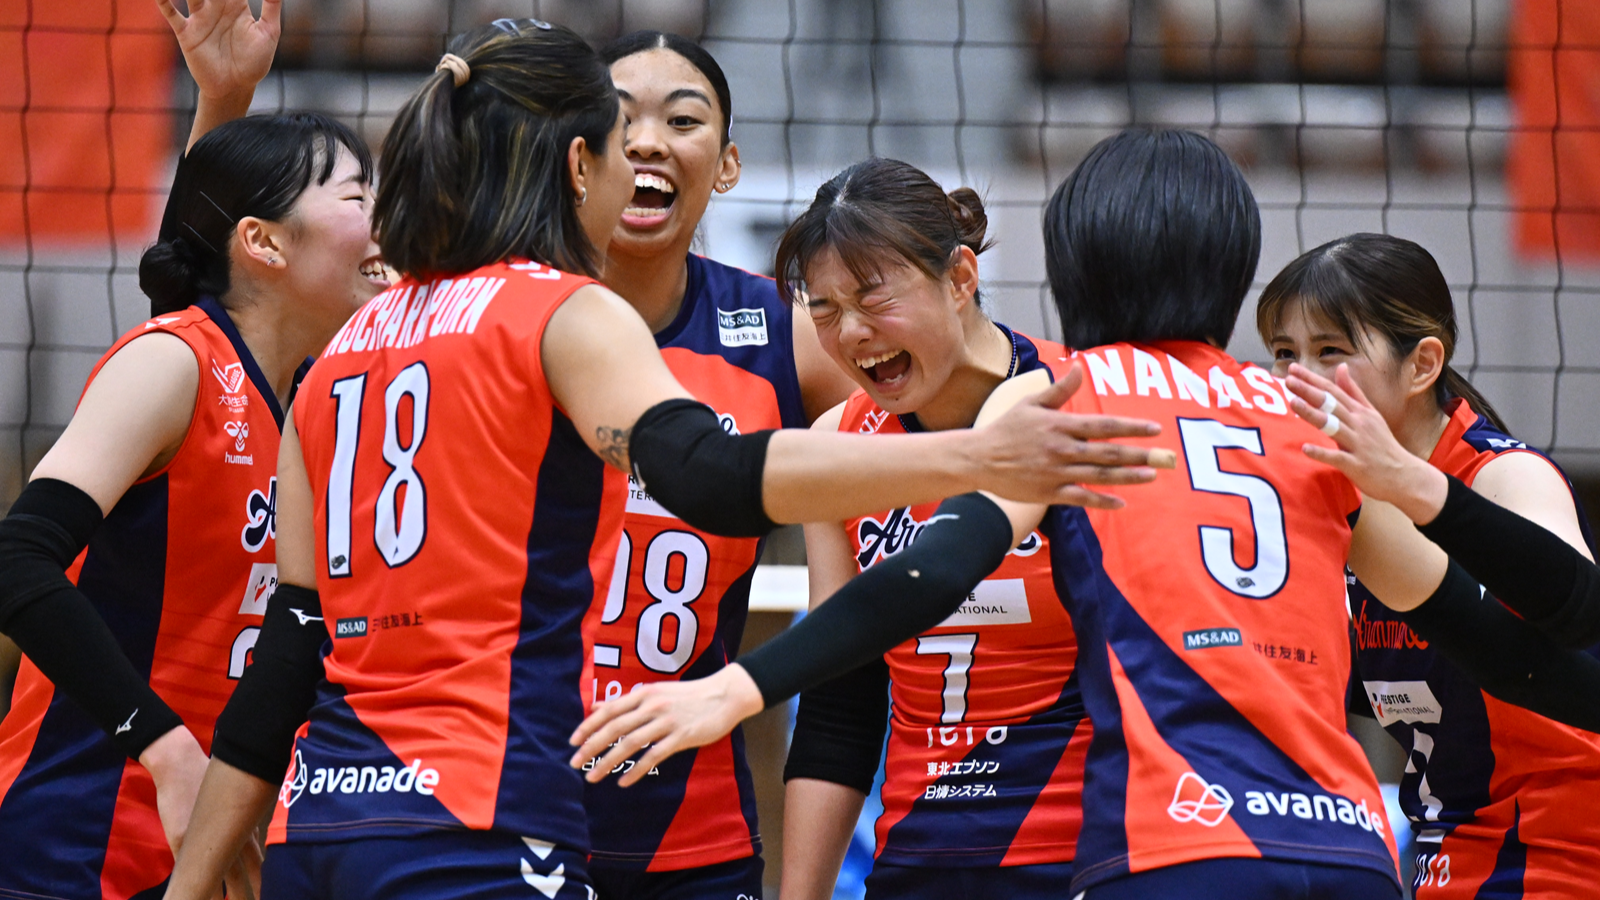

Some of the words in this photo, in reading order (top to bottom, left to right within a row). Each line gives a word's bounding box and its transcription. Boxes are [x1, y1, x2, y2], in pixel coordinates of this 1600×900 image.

[720, 314, 760, 327] MS&AD
[224, 451, 254, 466] hummel
[326, 360, 431, 579] 18
[1176, 416, 1290, 600] 5
[954, 605, 1009, 615] ATIONAL
[336, 620, 367, 634] MS&AD
[1186, 629, 1240, 648] MS&AD
[916, 632, 979, 727] 7
[309, 758, 440, 796] avanade
[926, 758, 1000, 777] 東北エプソン
[924, 783, 998, 800] 日情システム
[1244, 790, 1386, 839] avanade
